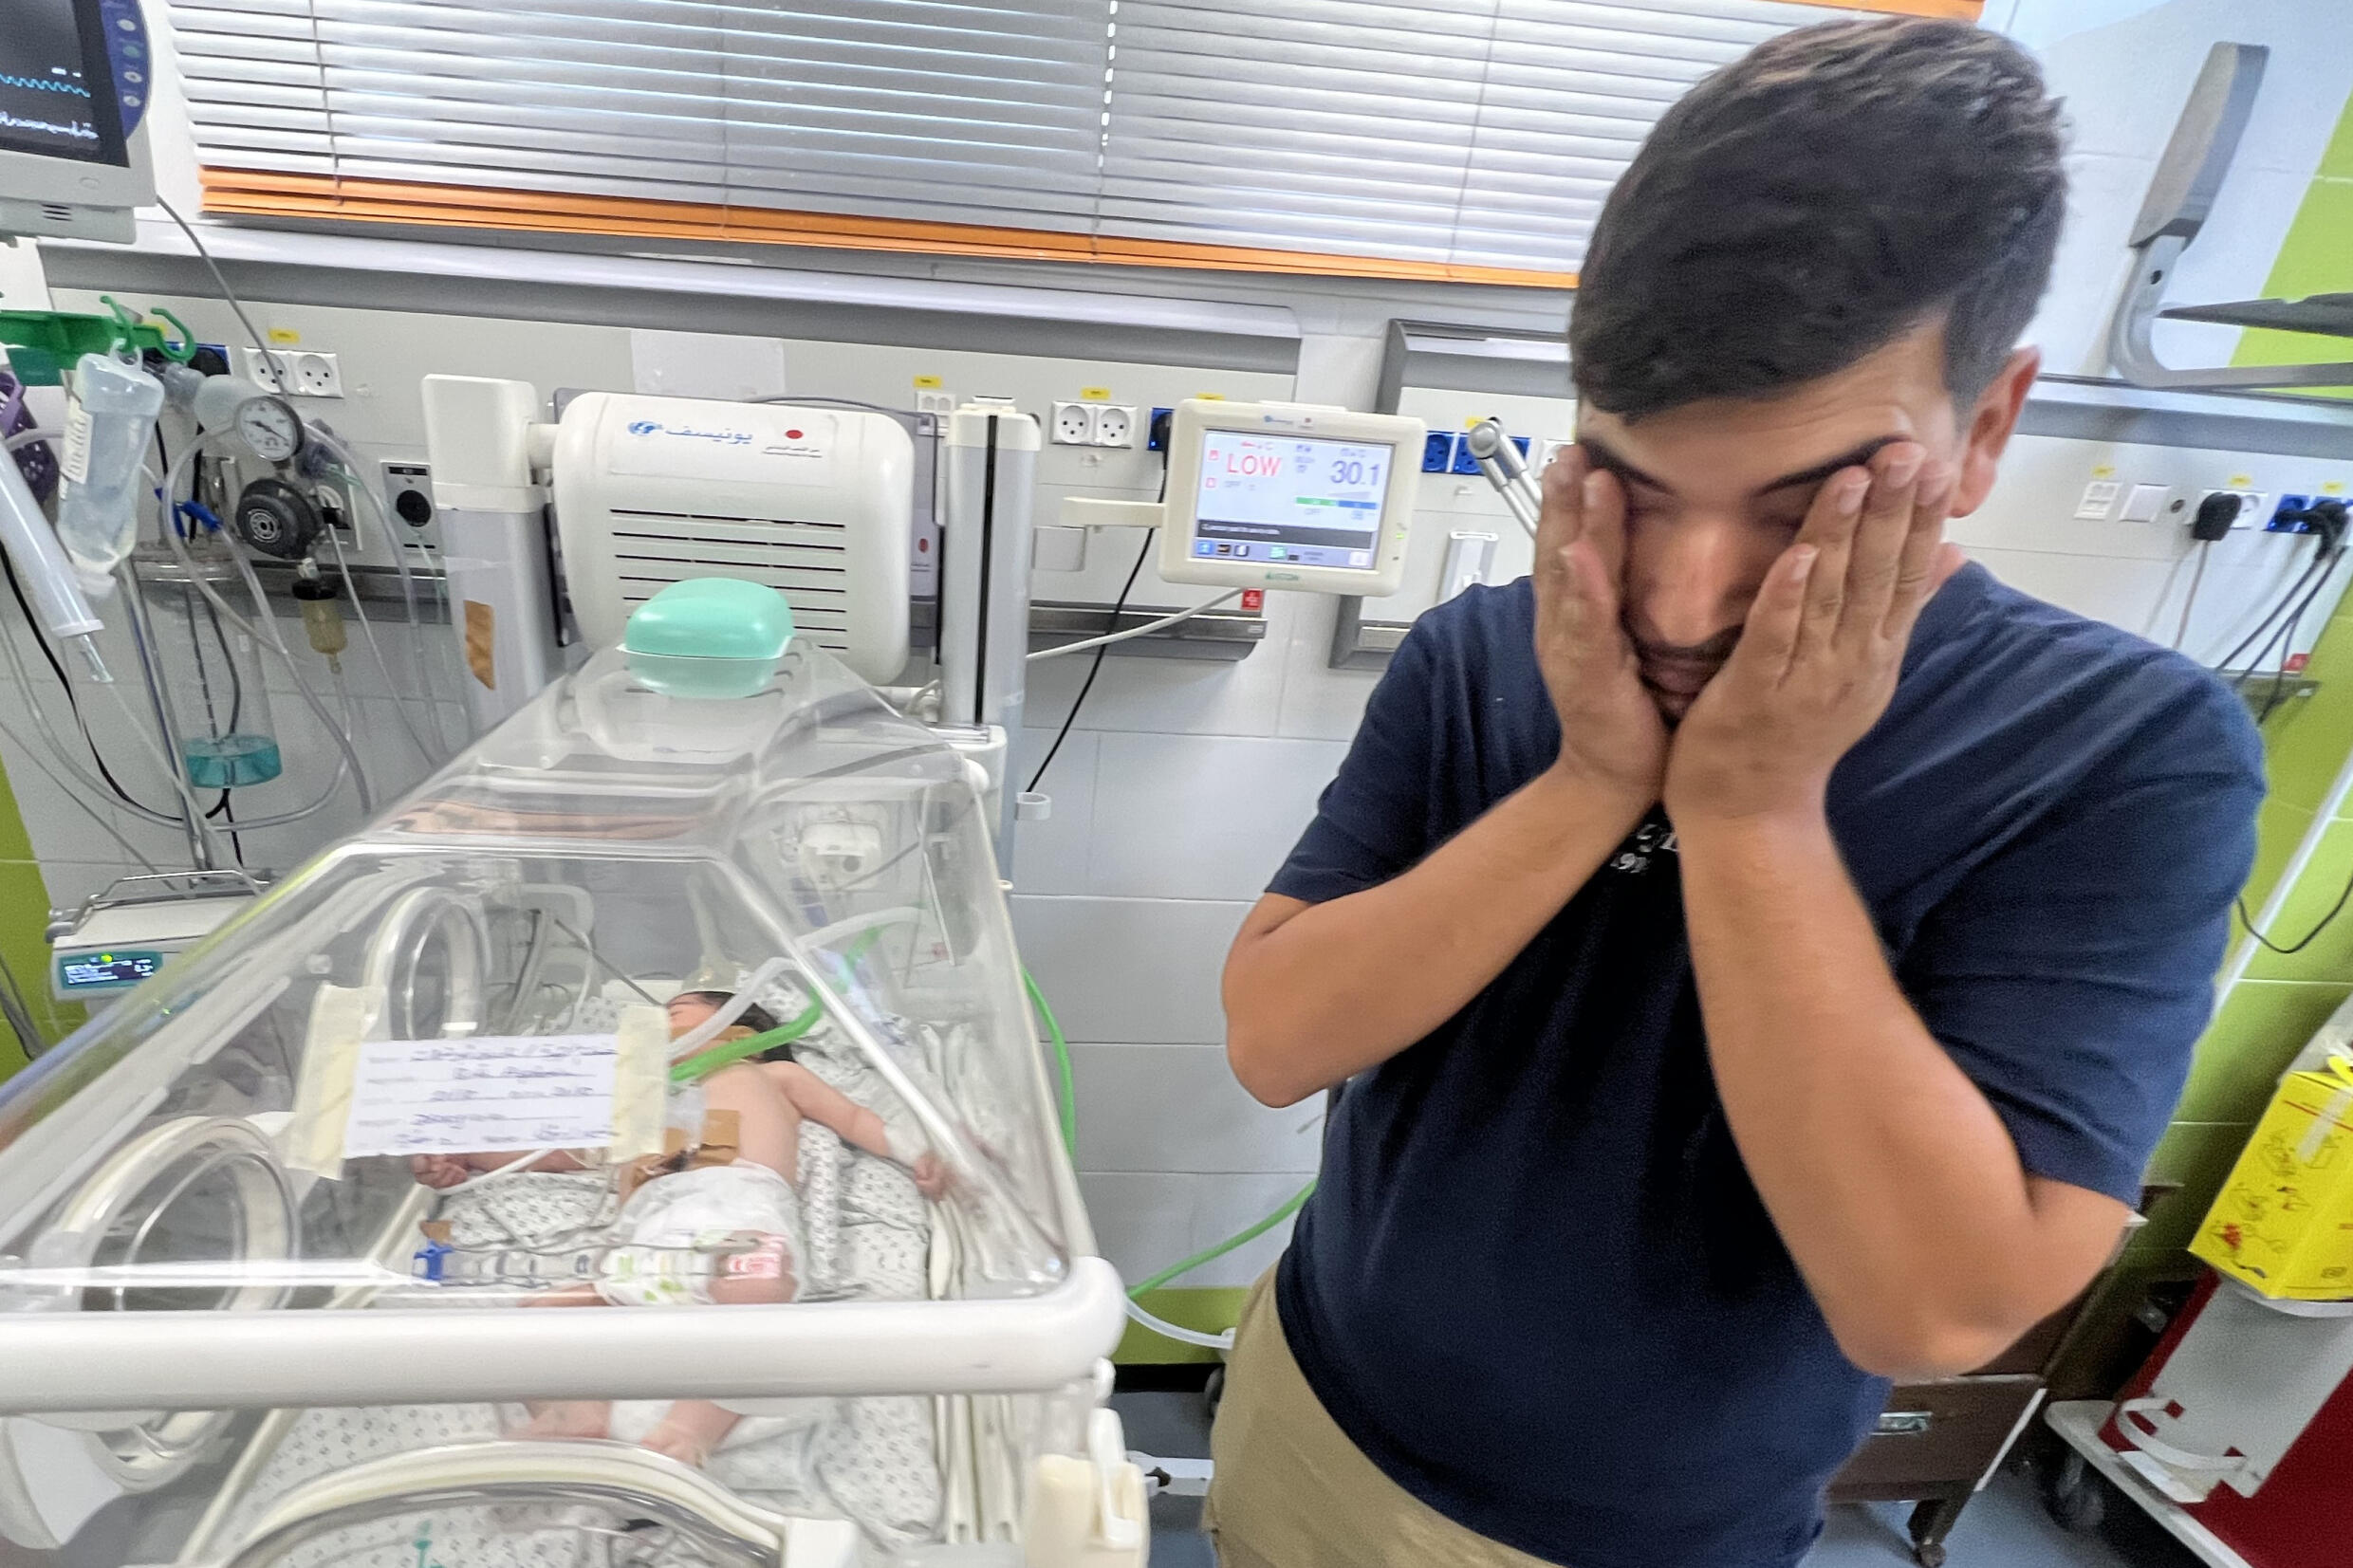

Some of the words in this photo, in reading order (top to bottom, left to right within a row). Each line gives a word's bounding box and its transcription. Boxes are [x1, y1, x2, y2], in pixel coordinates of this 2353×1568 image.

[665, 425, 752, 445] يونيسف
[1227, 453, 1281, 476] LOW
[1330, 460, 1380, 486] 30.1
